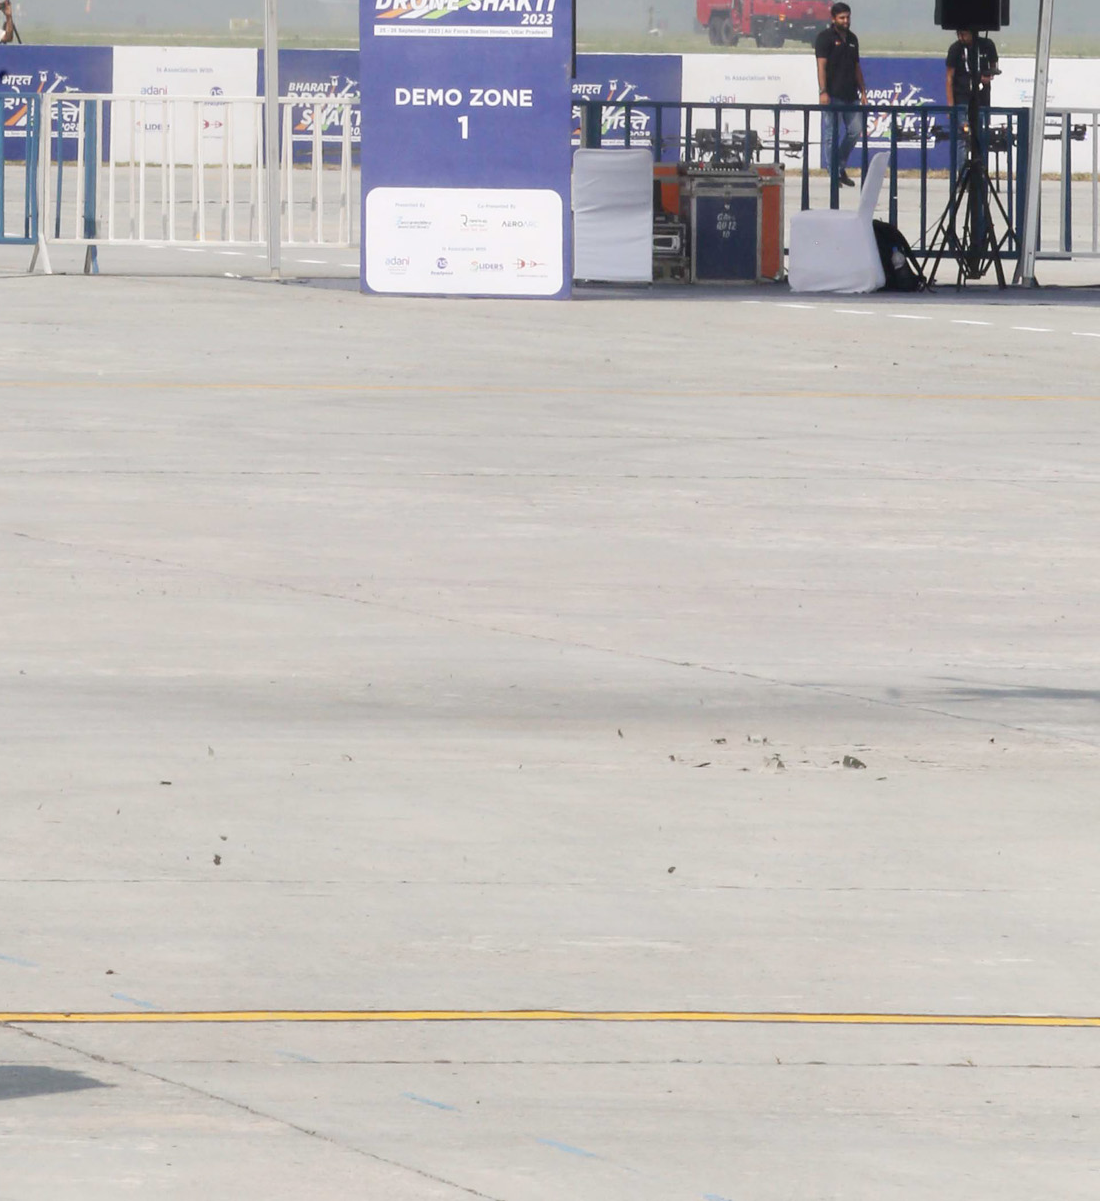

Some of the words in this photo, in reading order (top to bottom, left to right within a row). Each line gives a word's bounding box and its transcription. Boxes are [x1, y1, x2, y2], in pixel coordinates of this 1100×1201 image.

[520, 13, 553, 25] 2023
[398, 27, 427, 35] September
[1, 74, 33, 86] भारत
[140, 85, 168, 95] adani
[288, 81, 331, 92] BHARAT
[571, 83, 602, 95] भारत
[395, 88, 463, 106] DEMO
[469, 89, 533, 107] ZONE
[709, 93, 736, 104] adani
[457, 115, 469, 140] 1
[385, 256, 410, 266] adani
